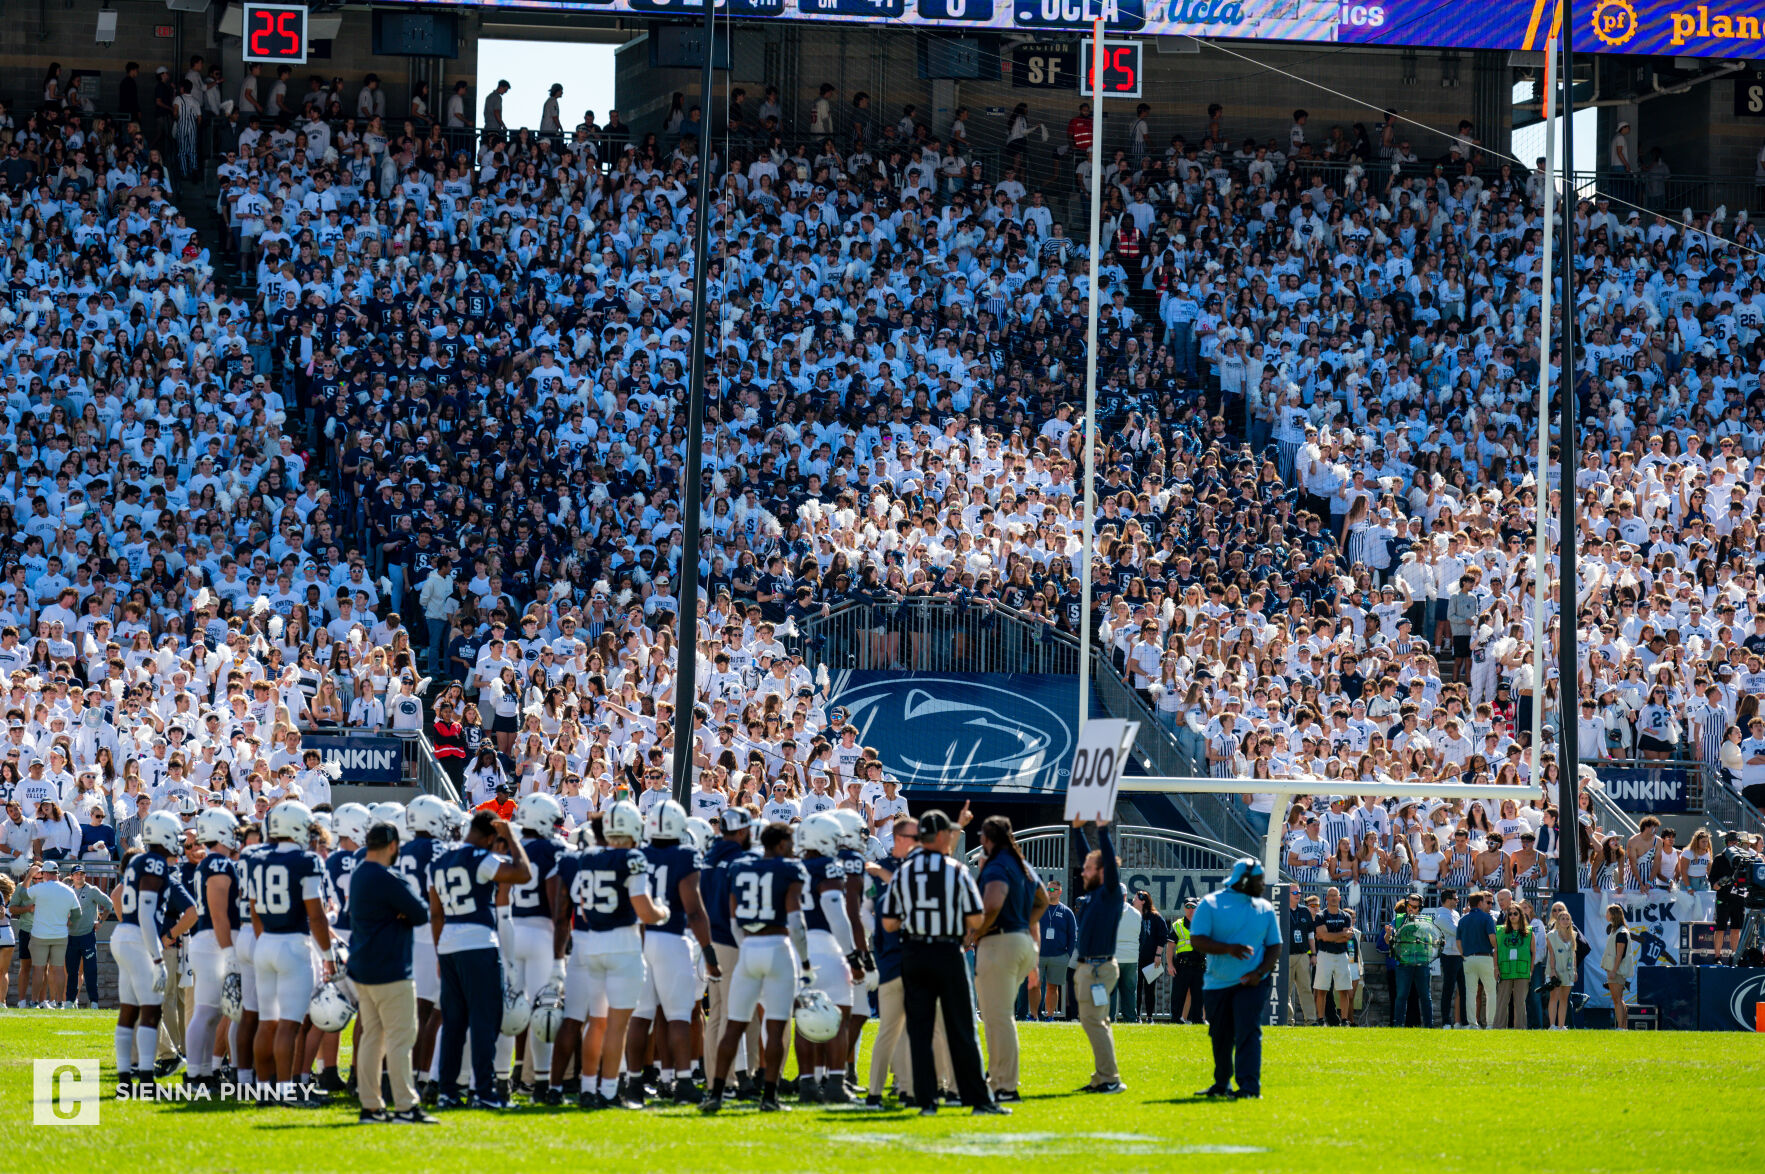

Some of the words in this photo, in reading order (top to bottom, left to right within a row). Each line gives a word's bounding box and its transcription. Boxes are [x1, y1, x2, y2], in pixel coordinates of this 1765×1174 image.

[1041, 0, 1119, 22] UCLA
[1602, 12, 1627, 33] pf
[1670, 5, 1765, 46] plan
[251, 11, 299, 55] 25
[1028, 57, 1062, 84] SF
[248, 203, 261, 217] 15
[1109, 271, 1116, 282] S
[267, 282, 282, 296] 15
[473, 298, 481, 309] S
[1740, 314, 1756, 327] 26
[1620, 355, 1634, 369] 10
[543, 378, 551, 390] S
[862, 492, 870, 505] S
[747, 519, 754, 532] S
[1142, 524, 1151, 537] S
[417, 554, 426, 567] S
[1124, 575, 1132, 588] S
[1015, 590, 1024, 602] S
[1070, 606, 1079, 618] S
[363, 709, 369, 727] 1
[471, 730, 479, 742] S
[316, 748, 397, 770] UNKIN'
[1071, 748, 1114, 788] DJO
[486, 776, 494, 788] S
[1603, 780, 1682, 800] UNKIN'
[145, 859, 164, 876] 36
[208, 859, 228, 874] 47
[844, 859, 863, 875] 99
[254, 865, 290, 915] 18
[434, 866, 477, 916] 42
[512, 862, 540, 909] 2
[915, 874, 939, 909] L
[735, 872, 776, 920] 31
[1129, 875, 1226, 917] STAT
[1620, 902, 1677, 923] NICK
[1647, 942, 1660, 958] 10
